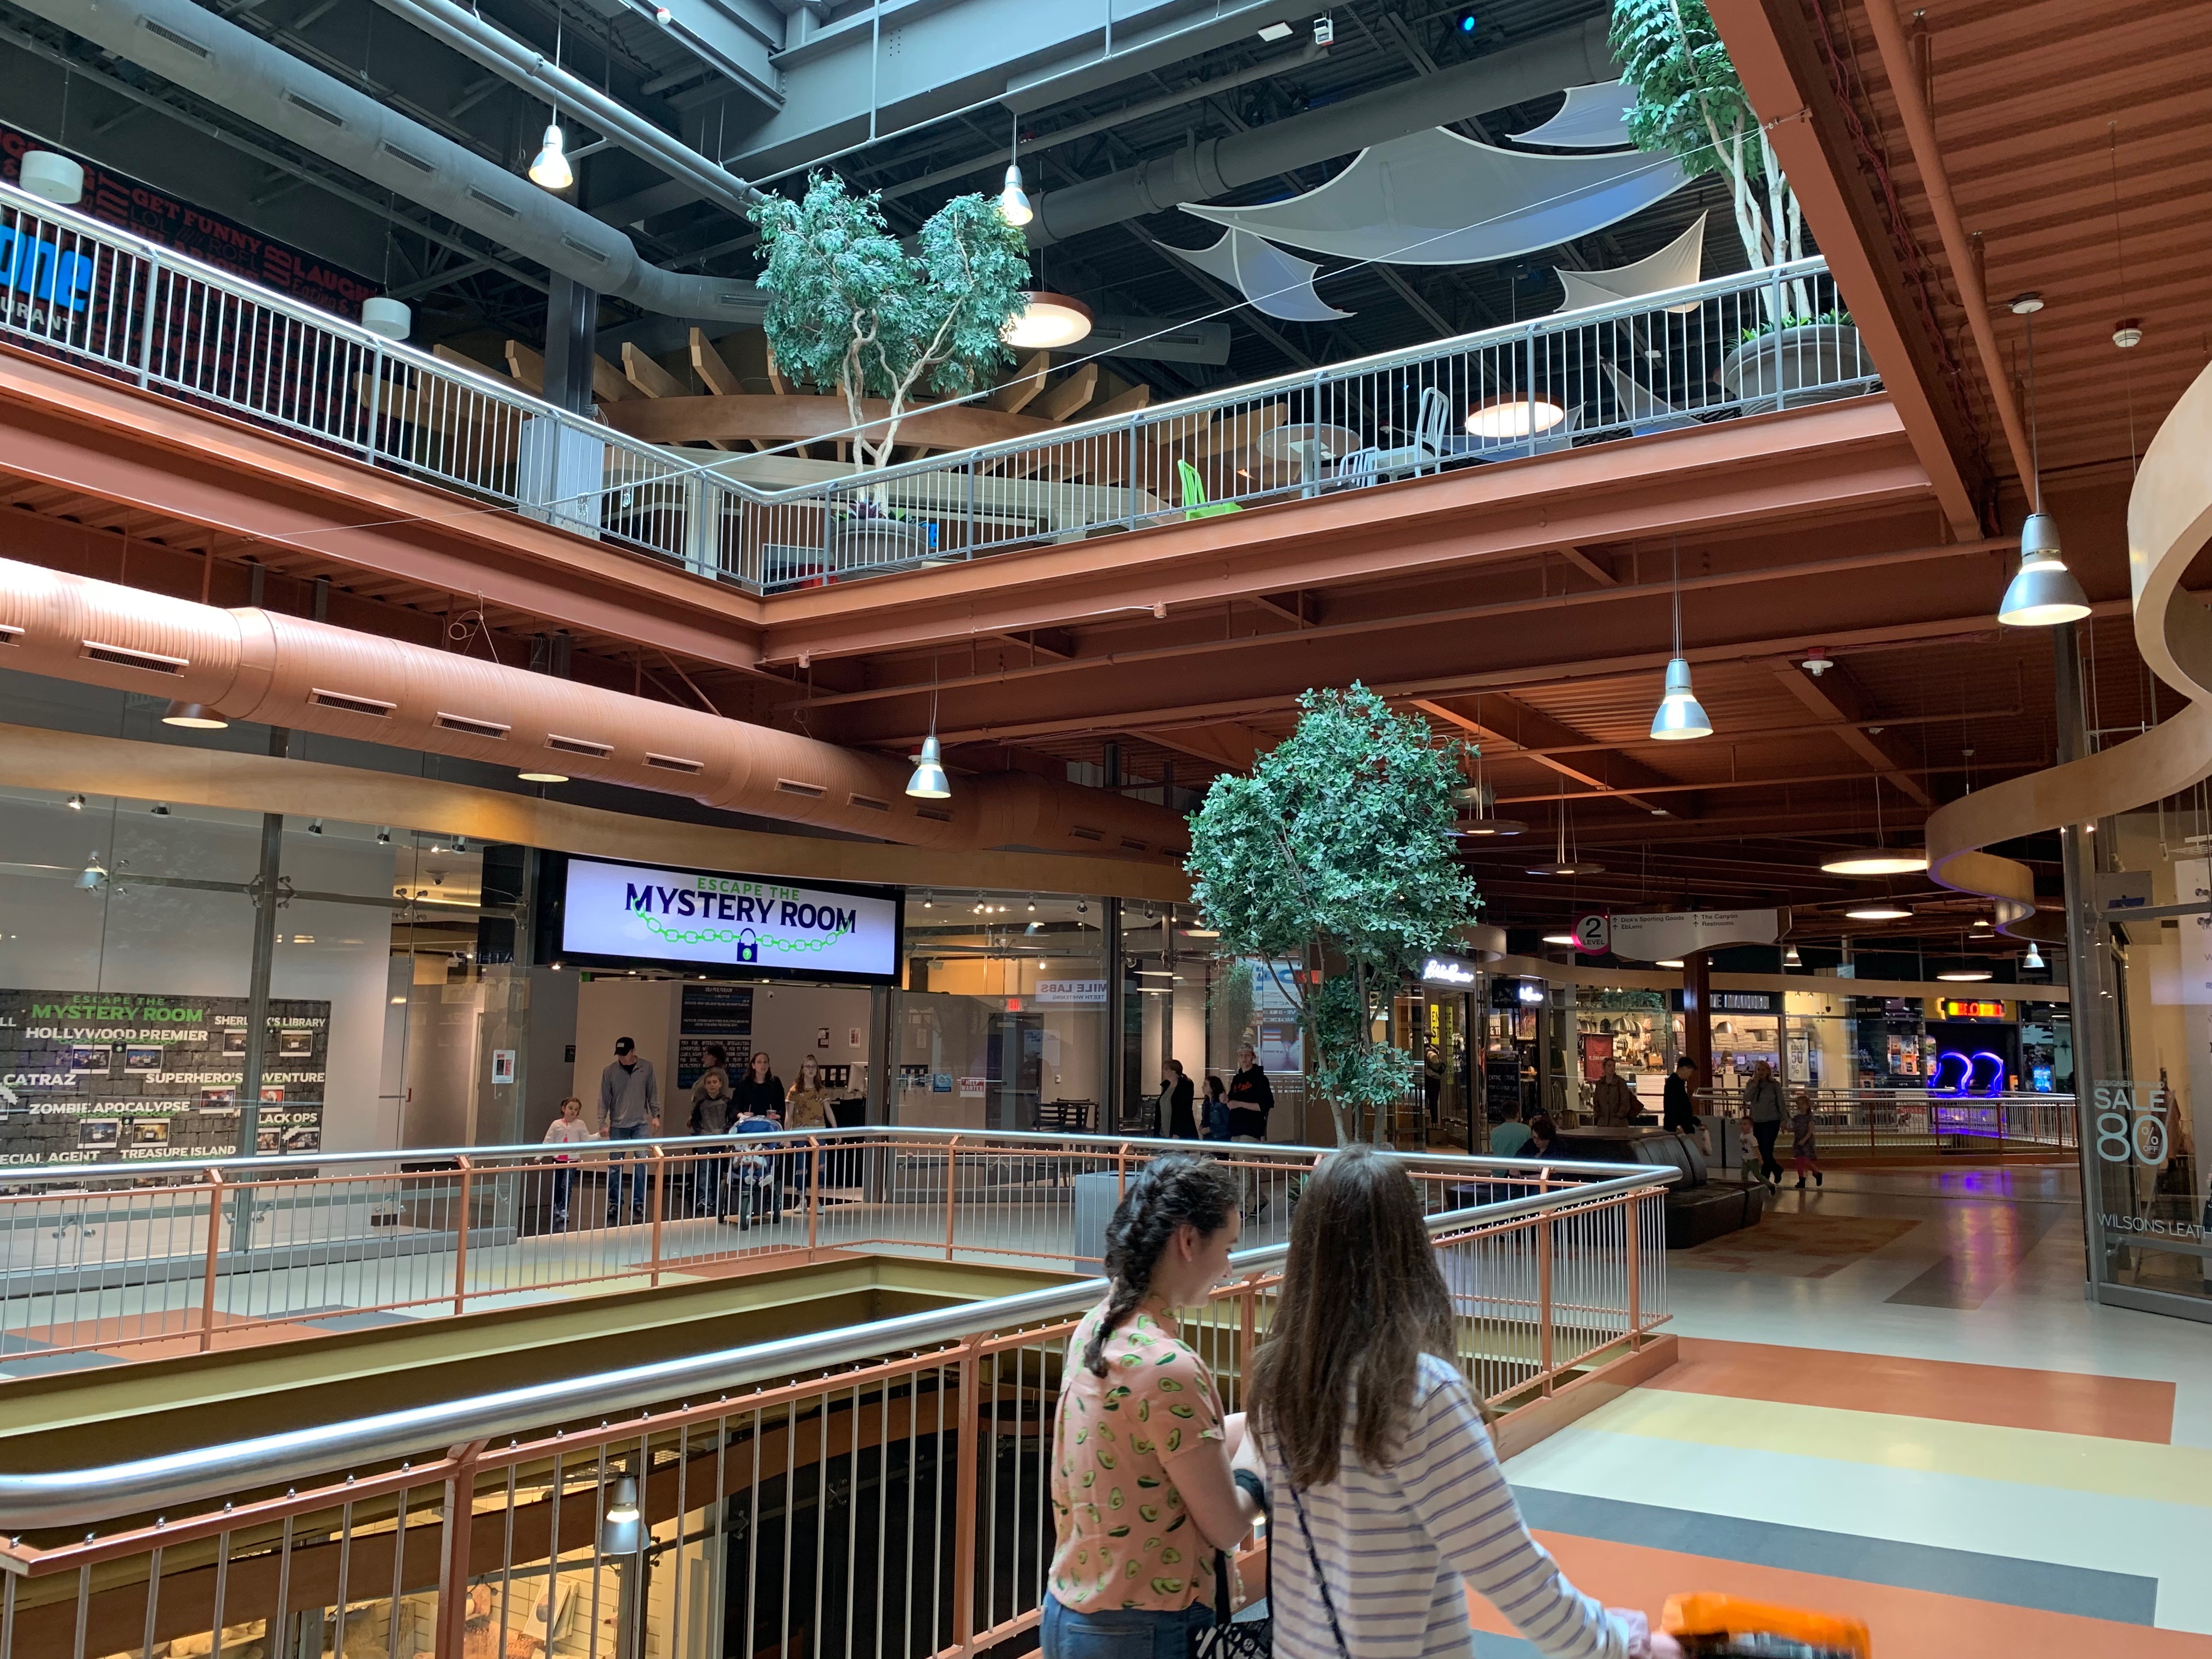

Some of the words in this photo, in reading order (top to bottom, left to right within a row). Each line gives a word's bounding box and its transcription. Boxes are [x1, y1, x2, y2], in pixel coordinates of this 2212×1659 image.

[131, 205, 171, 234] LOL
[131, 188, 180, 219] GET
[183, 208, 262, 254] FUNNY
[697, 877, 763, 897] ESCAPE
[769, 887, 800, 901] THE
[625, 883, 775, 923] MYSTERY
[780, 900, 856, 933] ROOM
[1585, 918, 1601, 938] 2
[73, 995, 131, 1005] ESCAPE
[138, 997, 166, 1006] THE
[32, 1004, 140, 1020] MYSTERY
[143, 1007, 203, 1023] ROOM
[283, 1017, 326, 1028] LIBRARY
[25, 1027, 137, 1040] HOLLYWOOD
[139, 1030, 208, 1041] PREMIER
[1791, 1051, 1803, 1064] 50
[3, 1074, 77, 1086] CATRAZ
[145, 1072, 243, 1084] SUPERHERO'S
[2094, 1079, 2133, 1087] DESIGNER
[2094, 1088, 2167, 1113] SALE
[29, 1103, 91, 1115] ZOMBIE
[93, 1101, 190, 1113] APOCALYPSE
[259, 1113, 291, 1124] LACK
[293, 1112, 318, 1122] OPS
[2096, 1112, 2168, 1165] 80
[2141, 1126, 2159, 1146] %
[48, 1150, 100, 1162] AGENT
[121, 1147, 188, 1159] TREASURE
[190, 1145, 236, 1156] ISLAND
[2097, 1212, 2164, 1234] WILSONS
